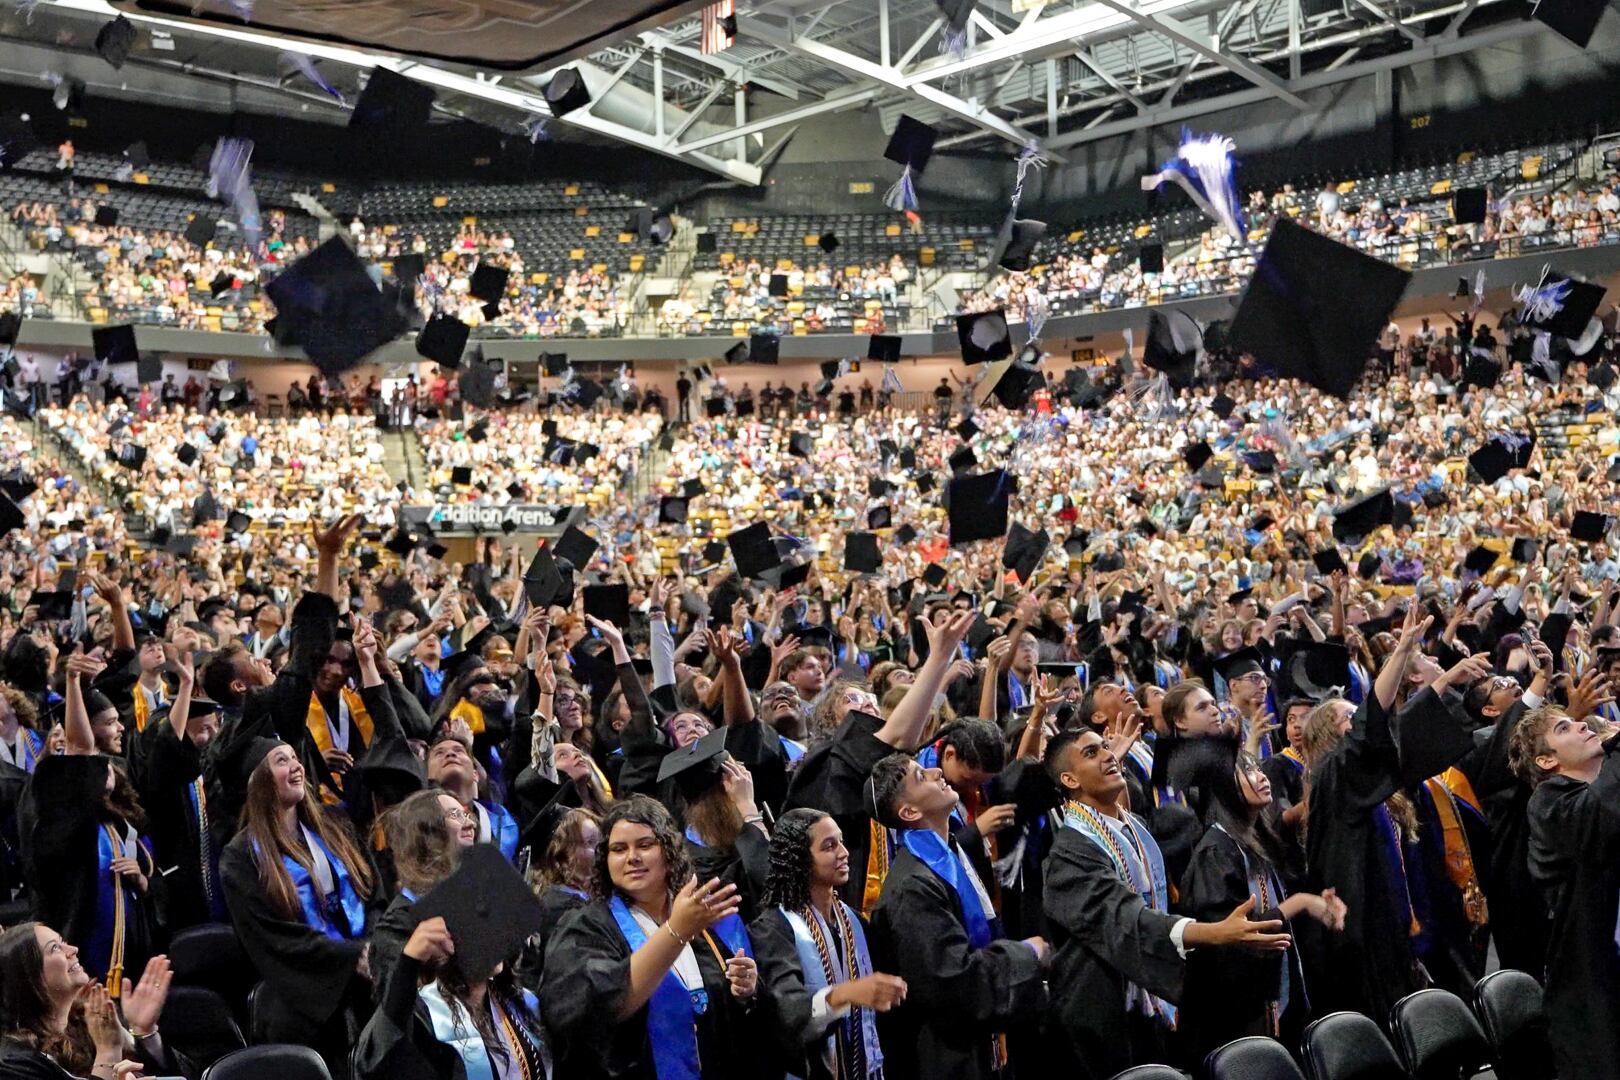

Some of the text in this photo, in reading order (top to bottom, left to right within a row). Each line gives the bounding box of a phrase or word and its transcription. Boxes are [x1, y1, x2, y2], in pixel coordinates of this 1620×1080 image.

[1411, 115, 1430, 128] 207
[426, 503, 555, 525] Addition Arena
